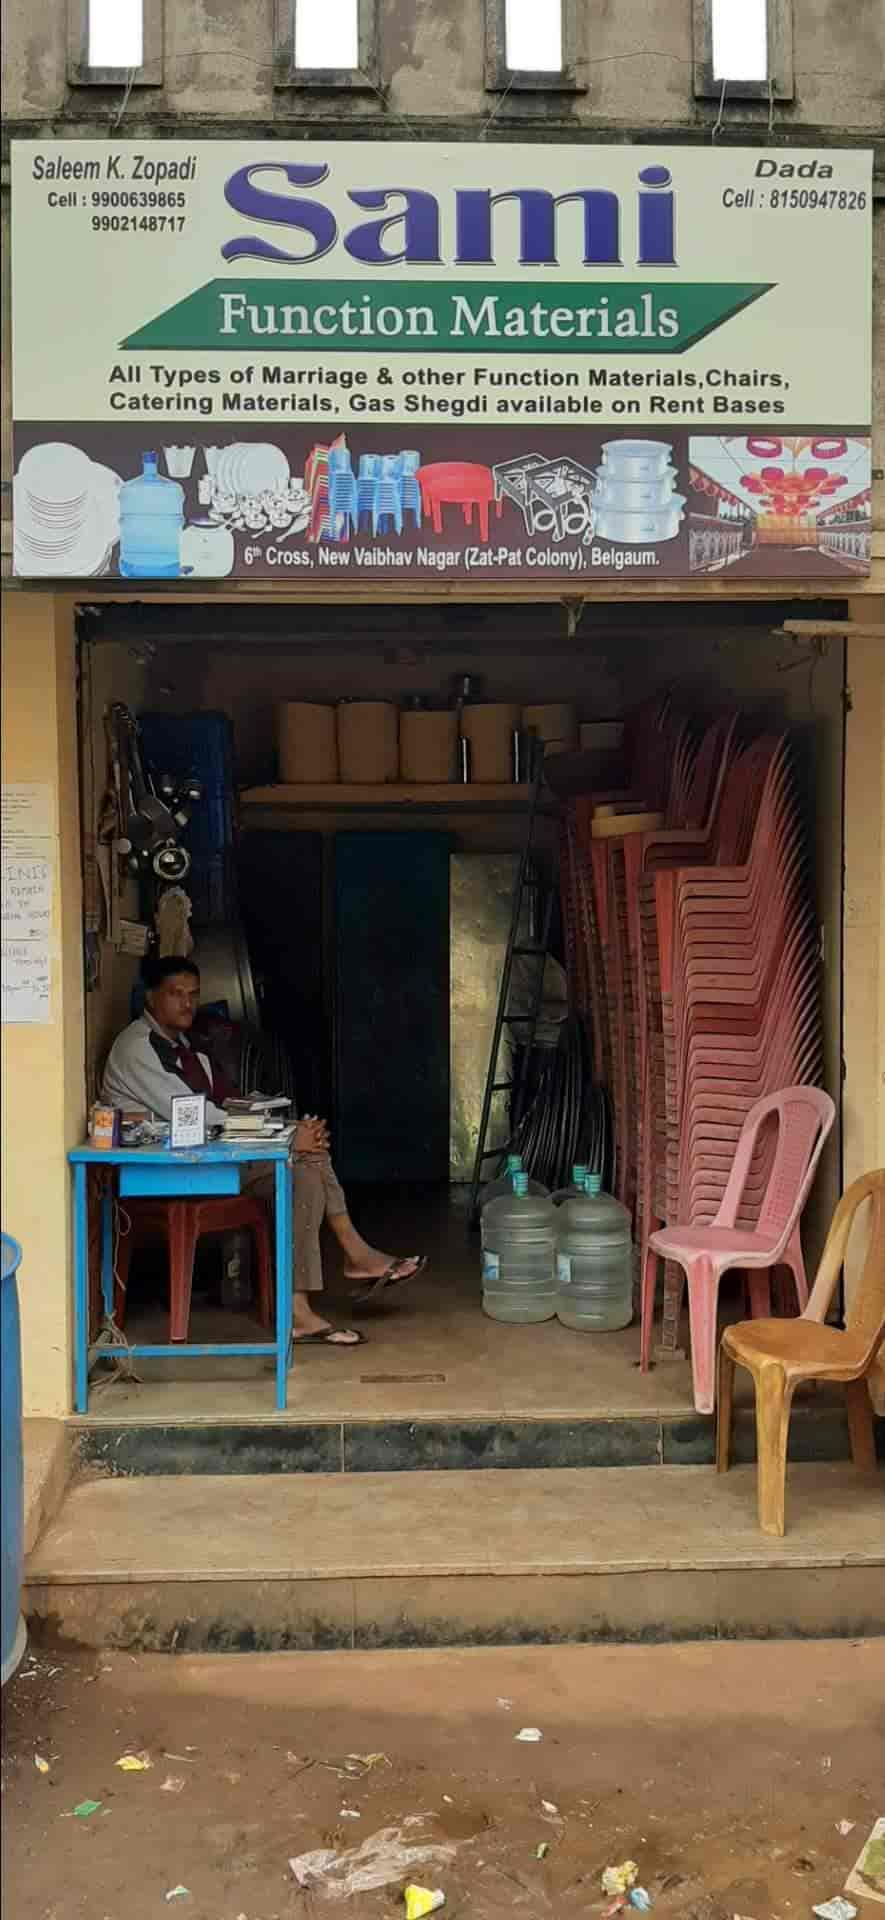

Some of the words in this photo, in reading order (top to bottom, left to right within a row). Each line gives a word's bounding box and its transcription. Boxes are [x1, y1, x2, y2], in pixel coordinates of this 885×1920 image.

[32, 155, 100, 180] Saleem
[107, 156, 125, 179] K.
[132, 155, 197, 185] Zopadi
[755, 160, 833, 178] Dada
[48, 192, 77, 207] Cell
[91, 192, 185, 207] 9900639865
[723, 189, 754, 208] Cell
[770, 189, 867, 210] 8150947826
[91, 216, 185, 232] 9902148717
[220, 162, 678, 266] Sami
[219, 293, 438, 335] Function
[450, 293, 679, 337] Materials
[109, 366, 141, 382] All
[150, 366, 220, 387] Types
[230, 366, 254, 384] of
[263, 367, 368, 388] Marriage
[377, 368, 393, 385] &
[403, 368, 465, 386] other
[474, 369, 579, 386] Function
[110, 393, 213, 414] Catering
[223, 394, 339, 414] Materials,
[349, 395, 396, 412] Gas
[405, 395, 488, 416] Shegdi
[497, 397, 602, 413] available
[612, 399, 640, 413] on
[650, 397, 704, 413] Rent
[713, 397, 785, 413] Bases
[266, 547, 314, 568] Cross,
[319, 548, 360, 566] New
[364, 547, 413, 566] Vaibhav
[417, 548, 461, 570] Nagar
[465, 547, 521, 569] (Zat-Pat
[526, 547, 587, 569] Colony),
[591, 548, 659, 570] Belgaum.
